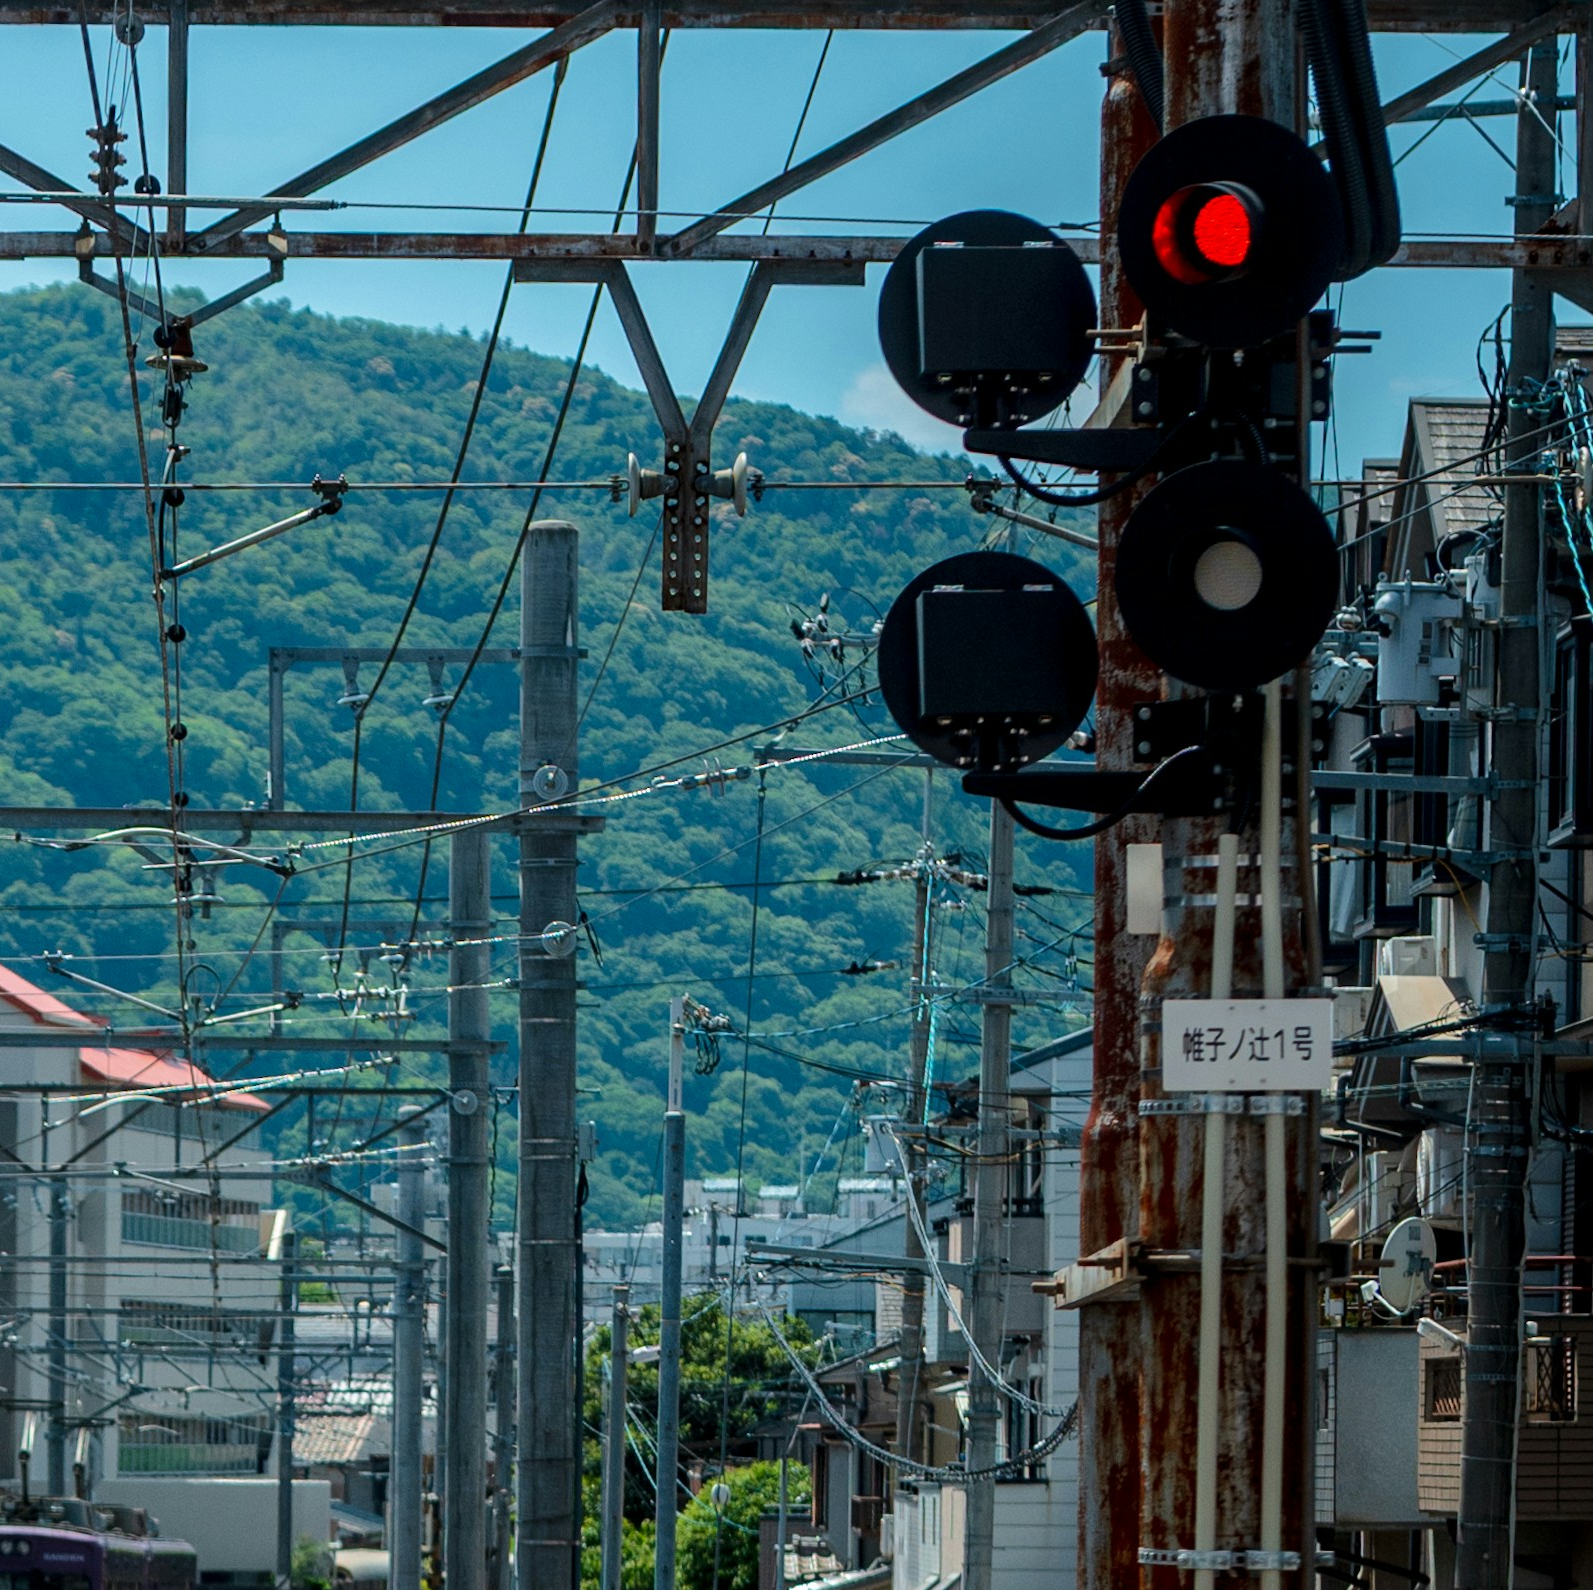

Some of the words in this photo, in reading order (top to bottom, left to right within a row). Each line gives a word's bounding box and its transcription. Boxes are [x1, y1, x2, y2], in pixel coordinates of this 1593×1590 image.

[1182, 1025, 1314, 1063] 帷子ノ辻1号
